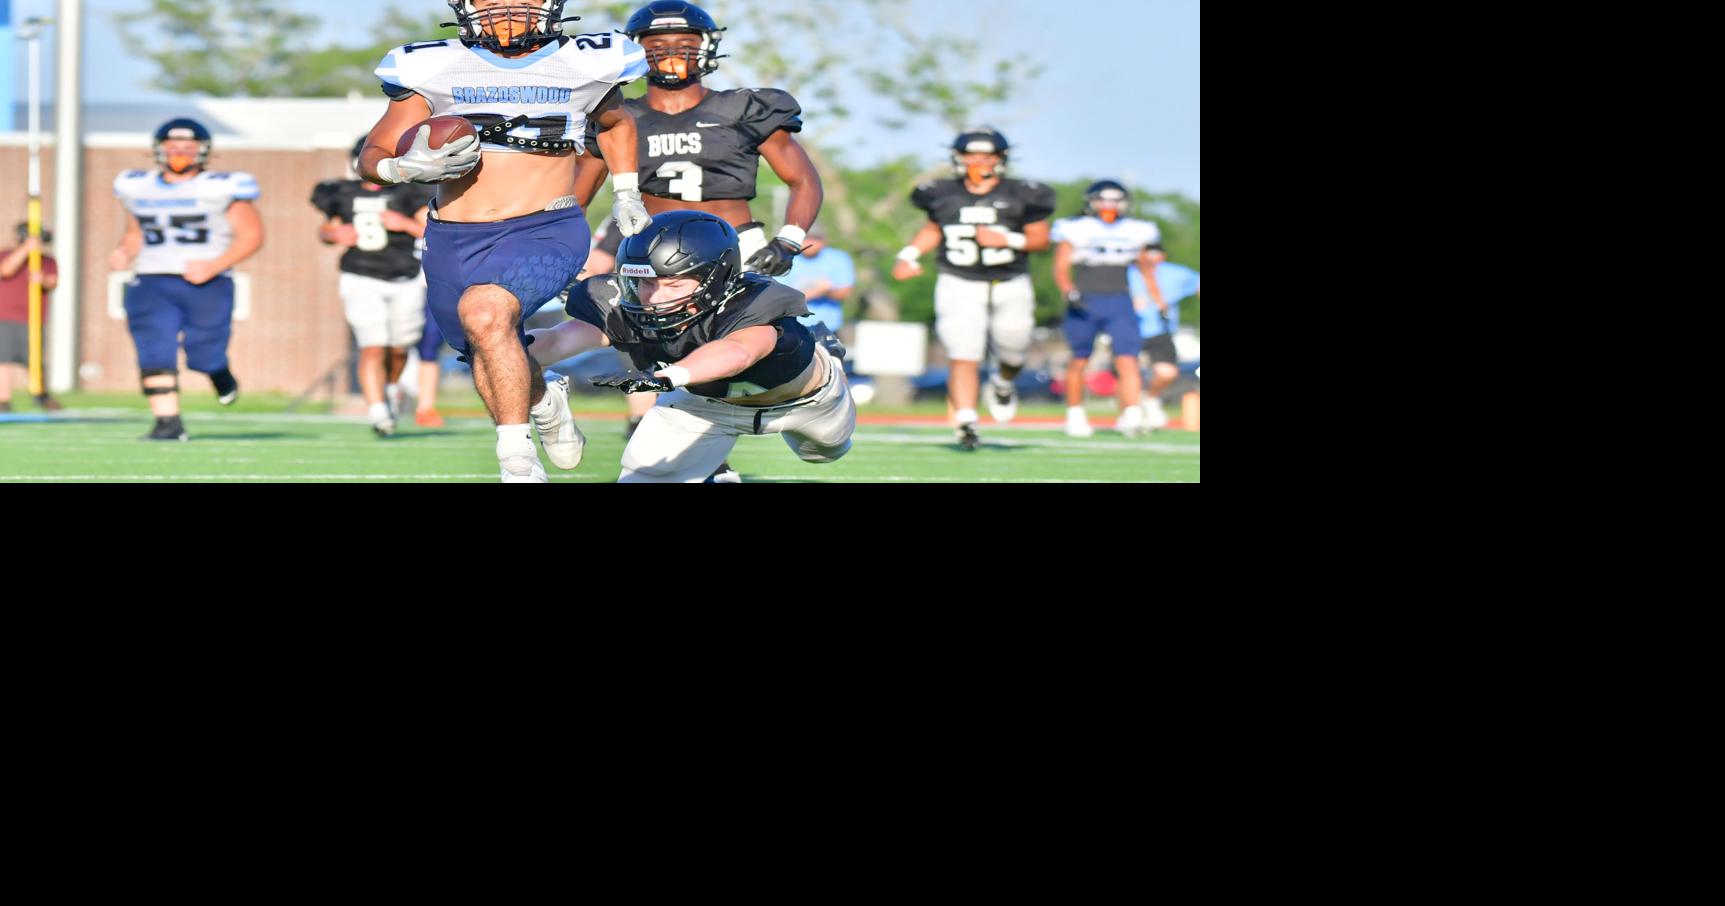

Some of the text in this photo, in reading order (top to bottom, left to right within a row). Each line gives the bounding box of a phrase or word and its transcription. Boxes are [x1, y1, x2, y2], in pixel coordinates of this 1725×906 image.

[452, 86, 572, 105] BRAZOSWOOD
[647, 132, 702, 157] BUCS
[656, 161, 702, 201] 3
[622, 267, 650, 275] Riddell
